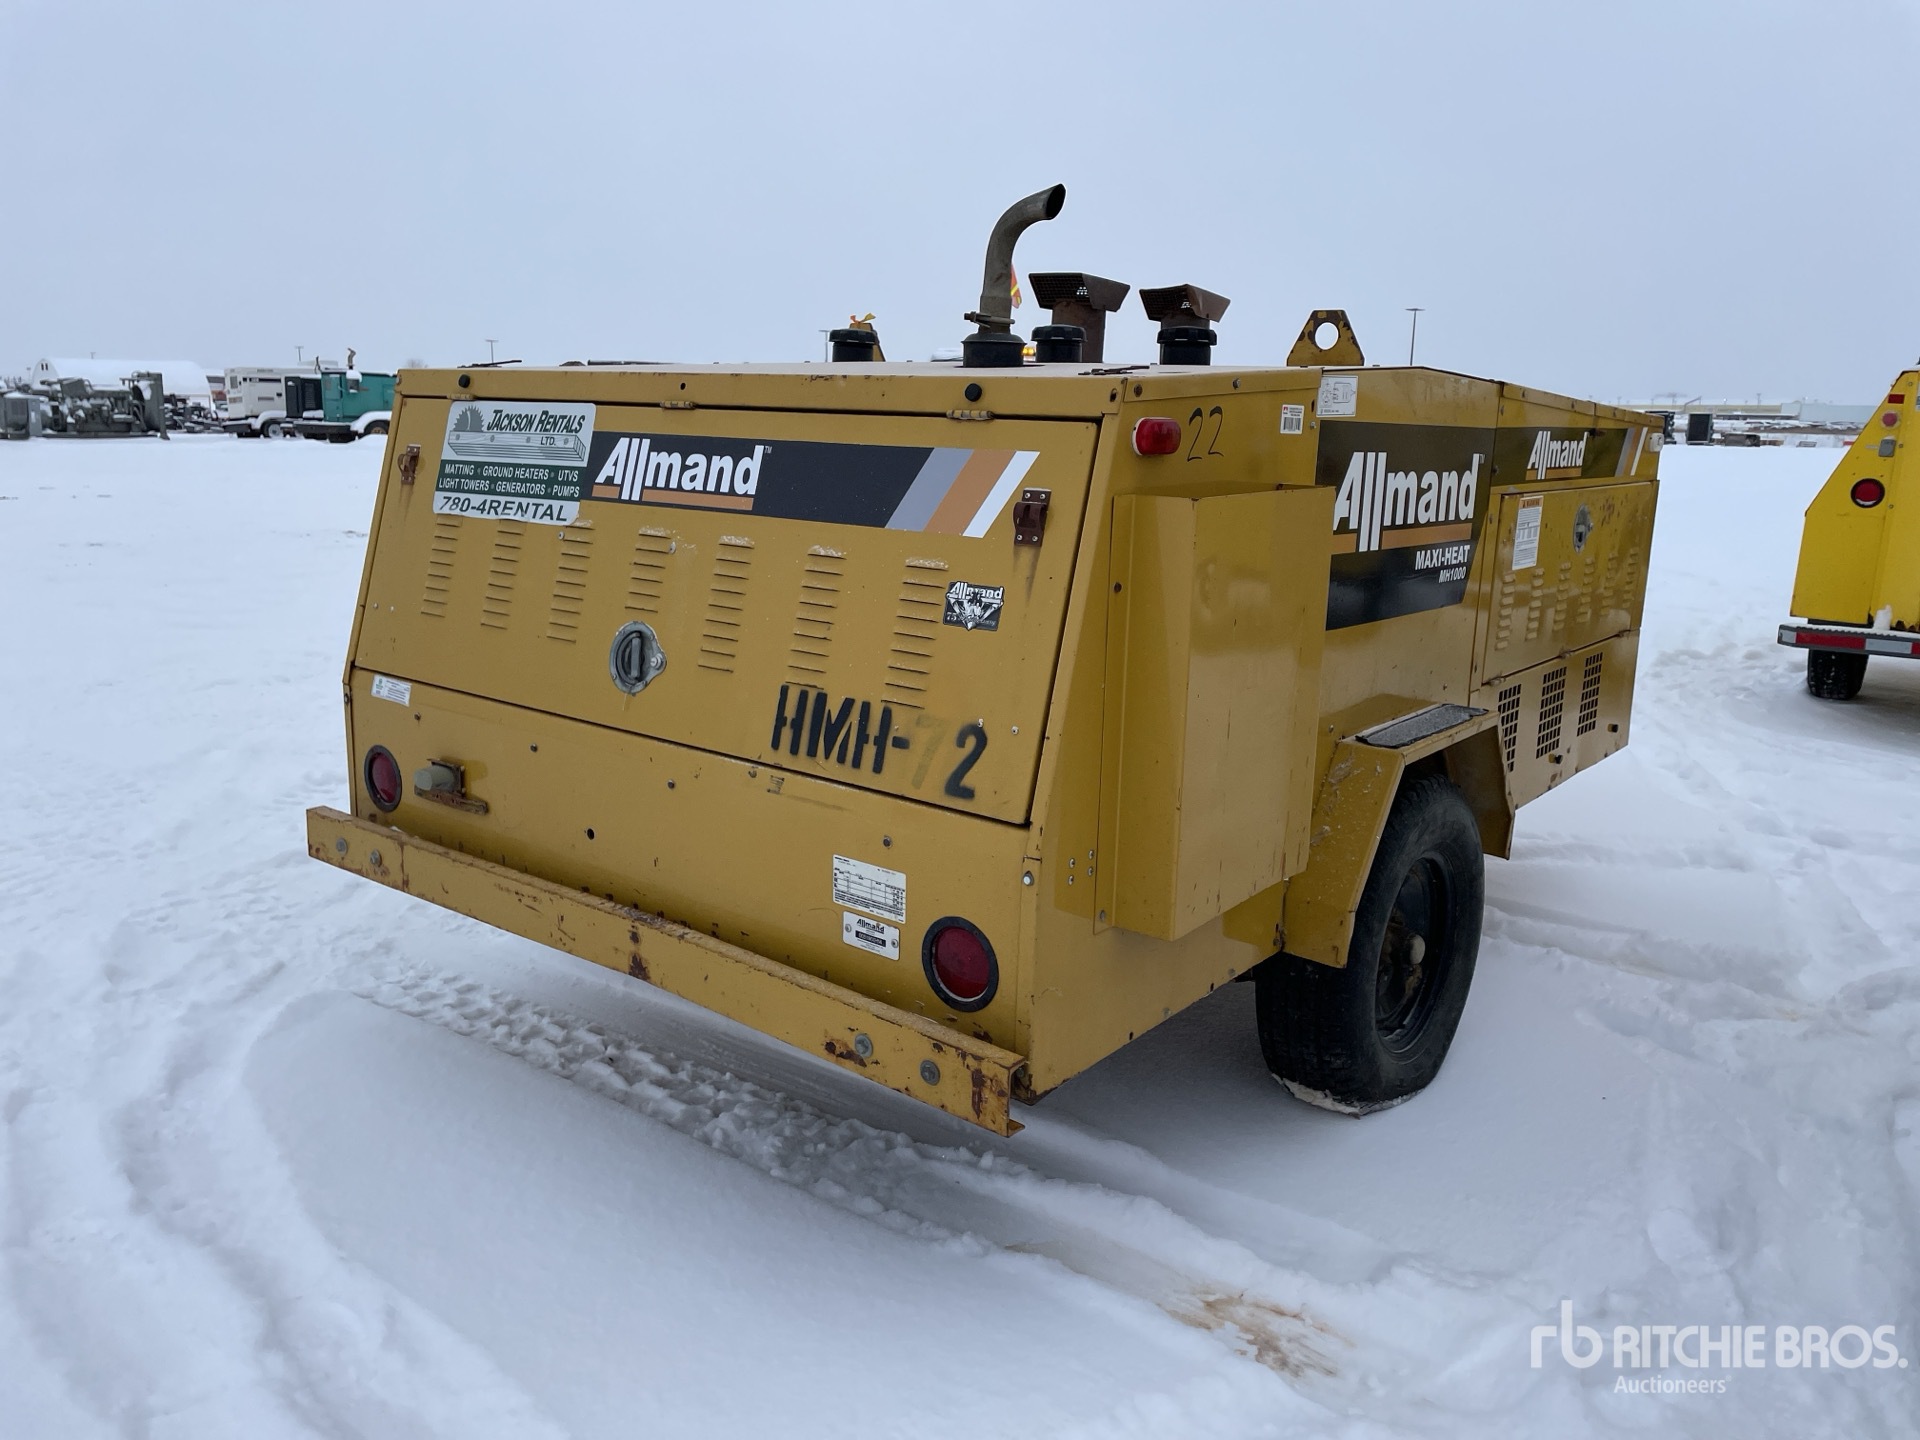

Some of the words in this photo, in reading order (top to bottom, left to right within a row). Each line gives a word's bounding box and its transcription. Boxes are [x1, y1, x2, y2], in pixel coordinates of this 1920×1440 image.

[487, 409, 538, 432] JACKSON
[535, 410, 586, 433] RENTALS
[1187, 406, 1224, 462] 22
[540, 436, 557, 446] LTD.
[1527, 430, 1589, 480] Allmand
[444, 464, 475, 475] MATTING
[483, 466, 513, 478] GROUND
[514, 467, 549, 480] HEATERS
[558, 470, 579, 482] UTVS
[595, 437, 764, 501] Allmand
[439, 478, 459, 489] LIGHT
[460, 479, 489, 491] TOWERS
[496, 481, 546, 495] GENERATORS
[552, 485, 580, 498] PUMPS
[438, 496, 568, 522] 780-4RENTAL
[1333, 451, 1480, 552] Allmand
[1415, 544, 1471, 570] MAXI-HEAT
[1438, 566, 1467, 583] MH1000
